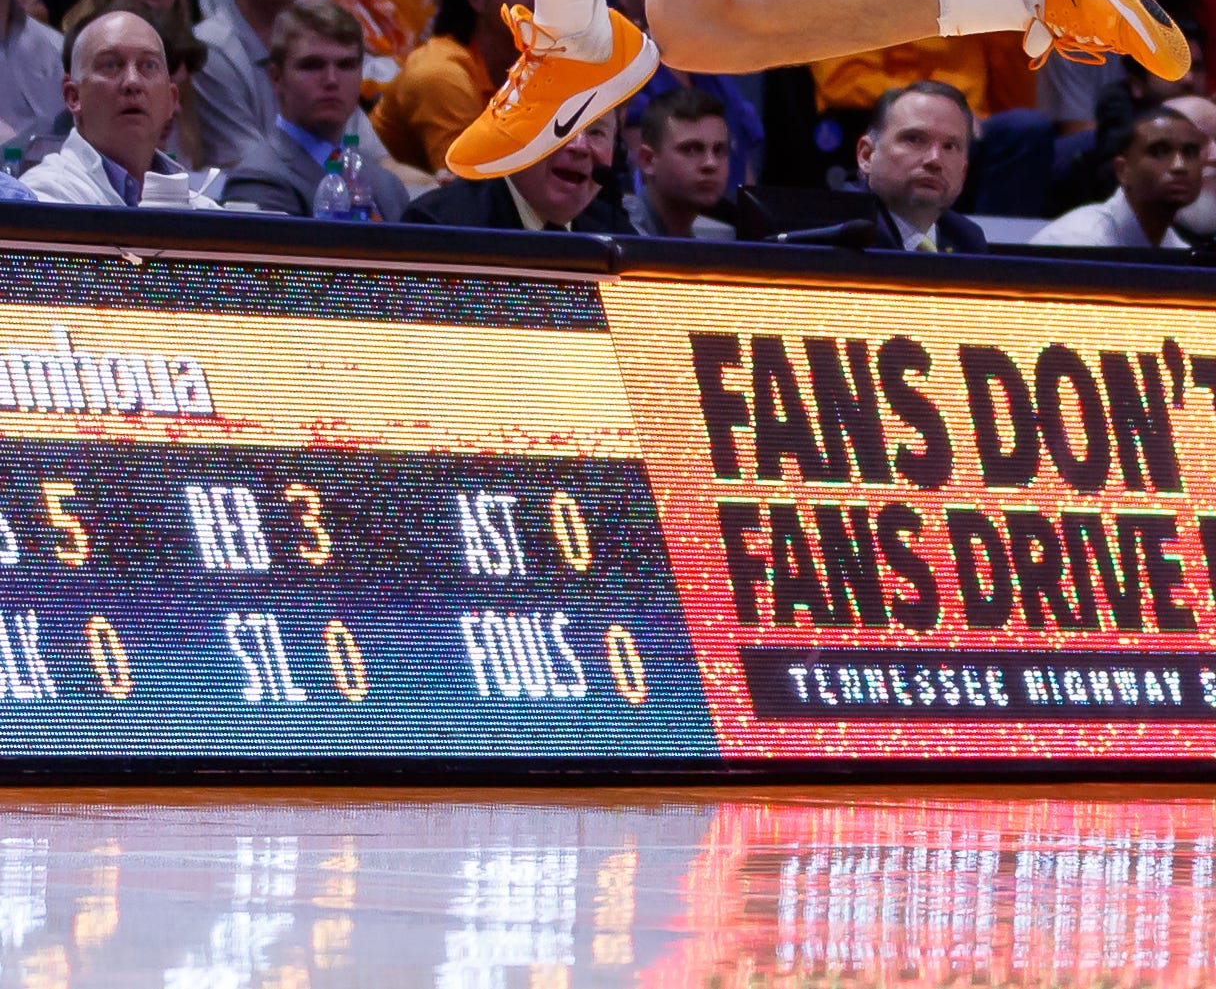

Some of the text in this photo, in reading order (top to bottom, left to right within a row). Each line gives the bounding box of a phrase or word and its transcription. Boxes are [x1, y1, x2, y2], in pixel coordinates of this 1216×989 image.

[0, 324, 215, 414] mhoua
[687, 332, 954, 492] FANS
[41, 481, 91, 566] 5
[185, 485, 271, 570] REB
[284, 483, 332, 565] 3
[456, 489, 527, 575] AST
[551, 491, 592, 572] 0
[716, 502, 944, 634] FANS
[944, 508, 1203, 632] DRIVE
[0, 609, 649, 704] LK 0 STL 0 FOULS 0
[788, 664, 1009, 706] TENNESSEE
[1023, 666, 1182, 705] HIGHWAY
